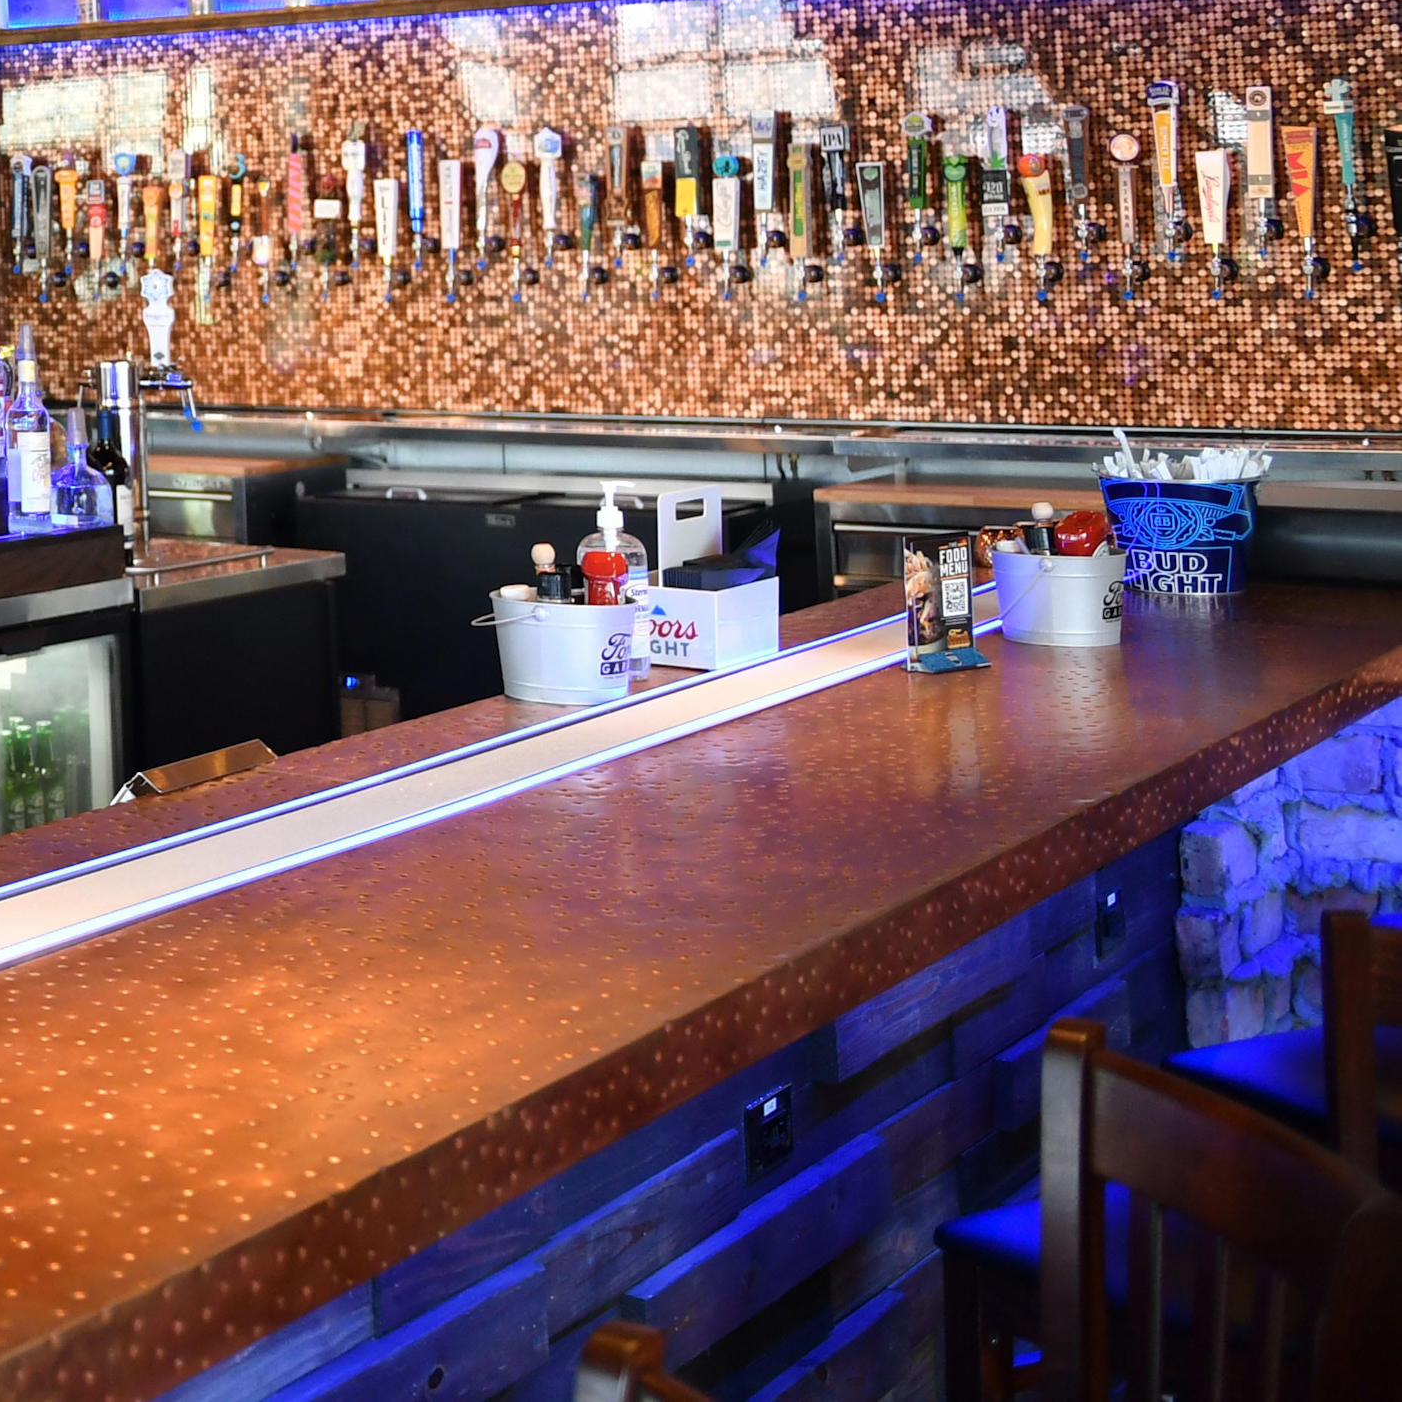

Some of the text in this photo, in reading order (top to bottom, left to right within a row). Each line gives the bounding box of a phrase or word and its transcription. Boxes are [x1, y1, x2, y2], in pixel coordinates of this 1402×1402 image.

[823, 133, 843, 147] IPA
[939, 546, 968, 565] FOOD
[1131, 549, 1208, 574] BUD
[939, 561, 969, 577] MENU
[650, 617, 699, 641] ors
[651, 639, 690, 658] GHT
